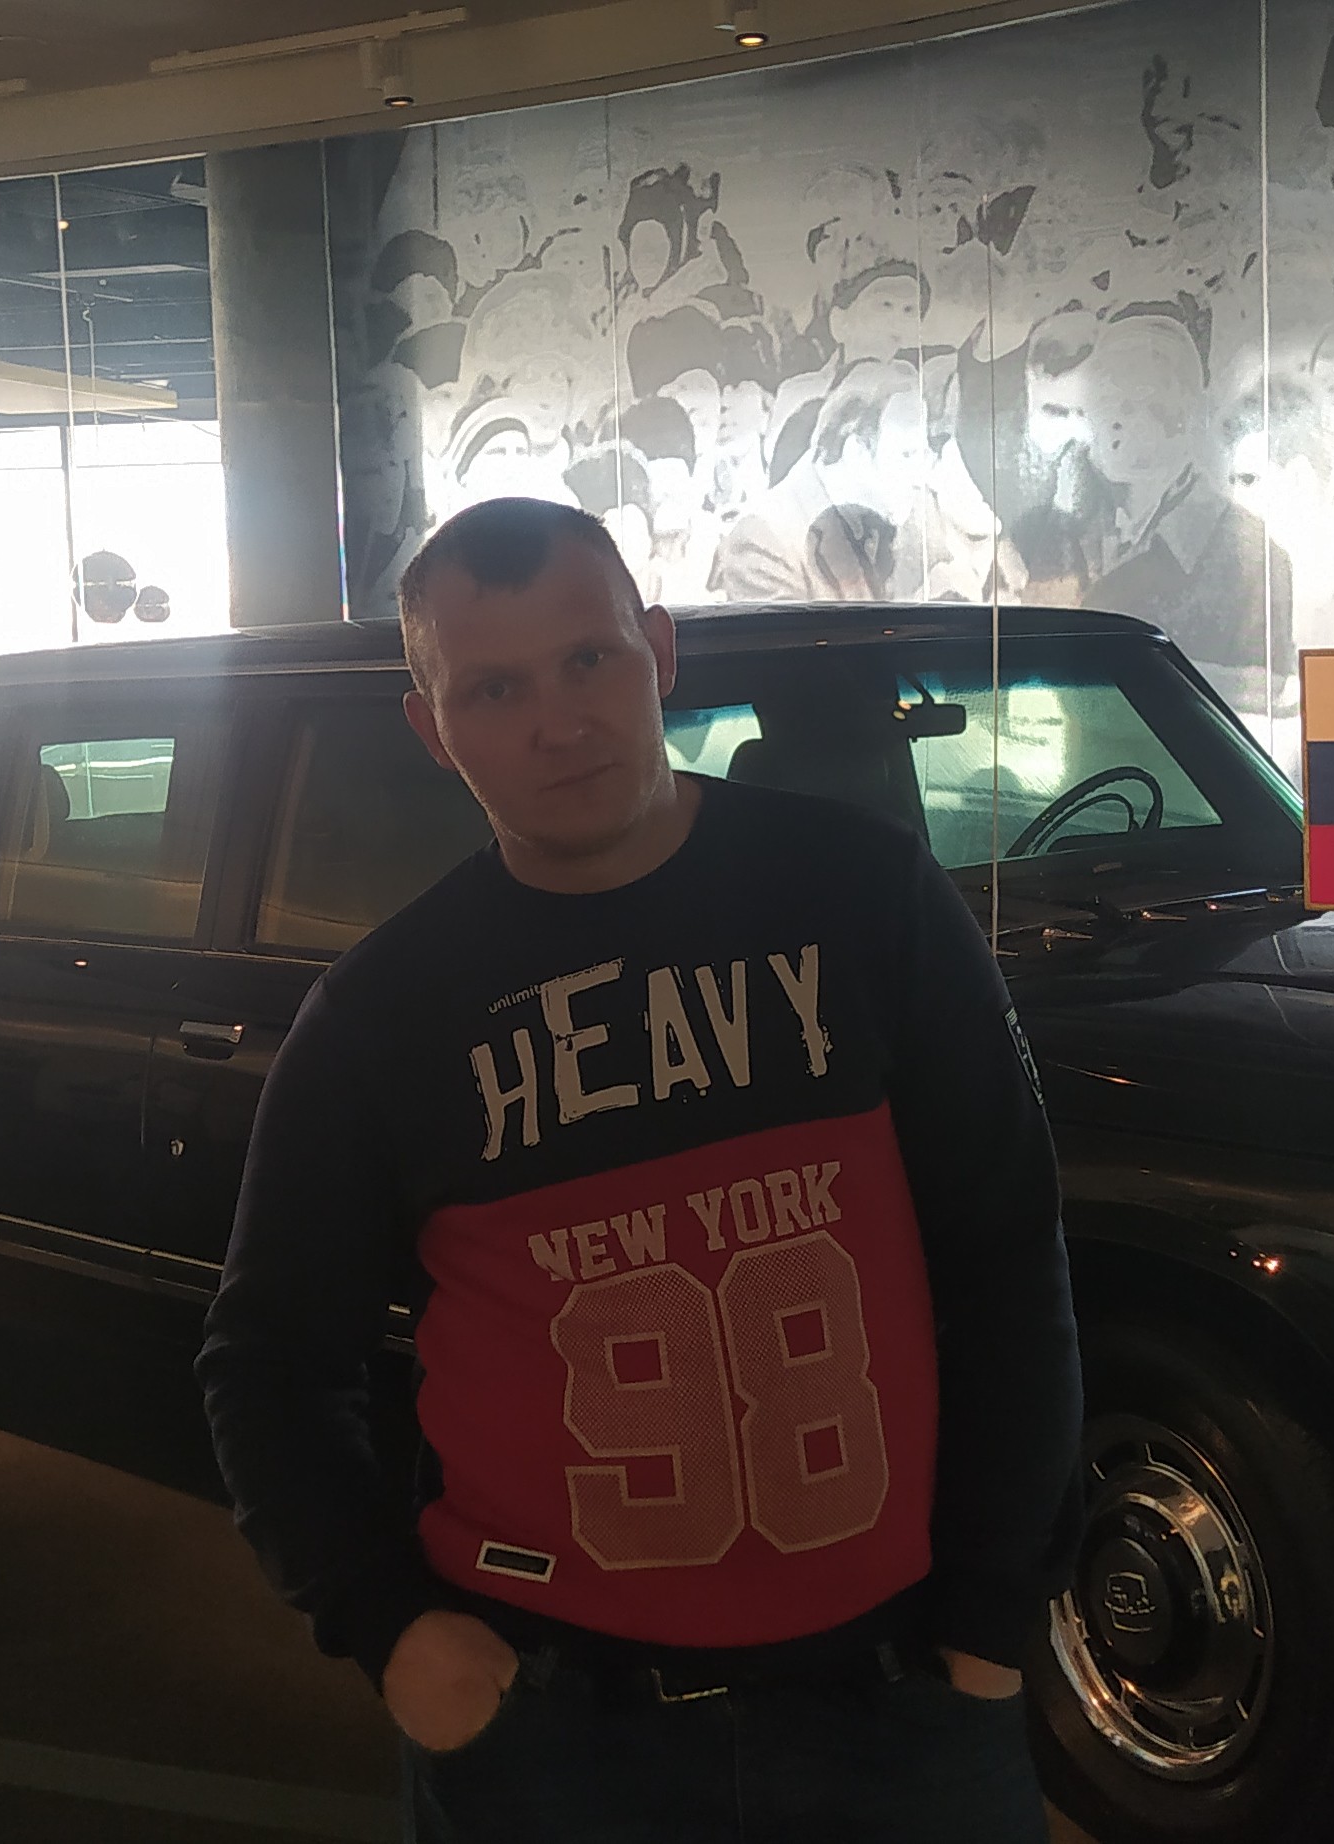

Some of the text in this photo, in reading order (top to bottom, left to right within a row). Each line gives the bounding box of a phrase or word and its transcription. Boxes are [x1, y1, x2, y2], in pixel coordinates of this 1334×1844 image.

[468, 942, 835, 1162] HEAVY
[527, 1160, 843, 1283] NEW YORK
[549, 1229, 890, 1571] 98
